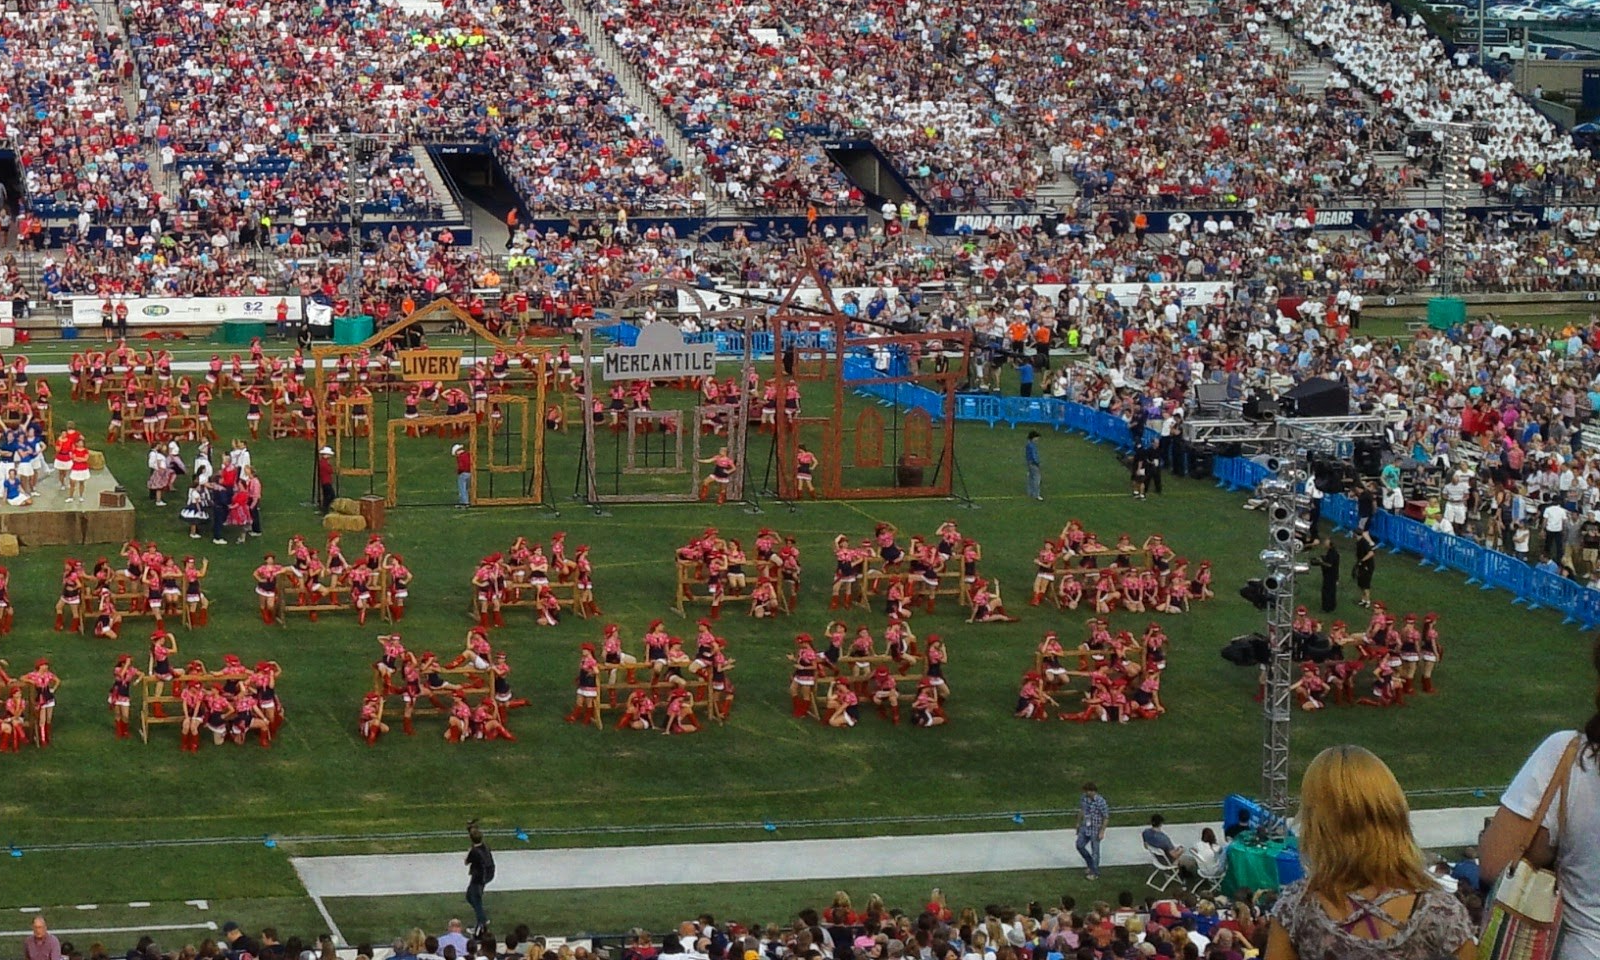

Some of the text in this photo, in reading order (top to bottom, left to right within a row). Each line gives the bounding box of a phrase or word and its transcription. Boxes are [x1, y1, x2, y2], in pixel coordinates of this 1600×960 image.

[954, 215, 992, 230] ROAR
[1189, 287, 1197, 297] 2
[253, 302, 263, 311] 2
[1386, 298, 1396, 306] 10
[61, 319, 73, 327] 30
[402, 356, 458, 375] LIVERY
[606, 352, 713, 374] MERCANTILE
